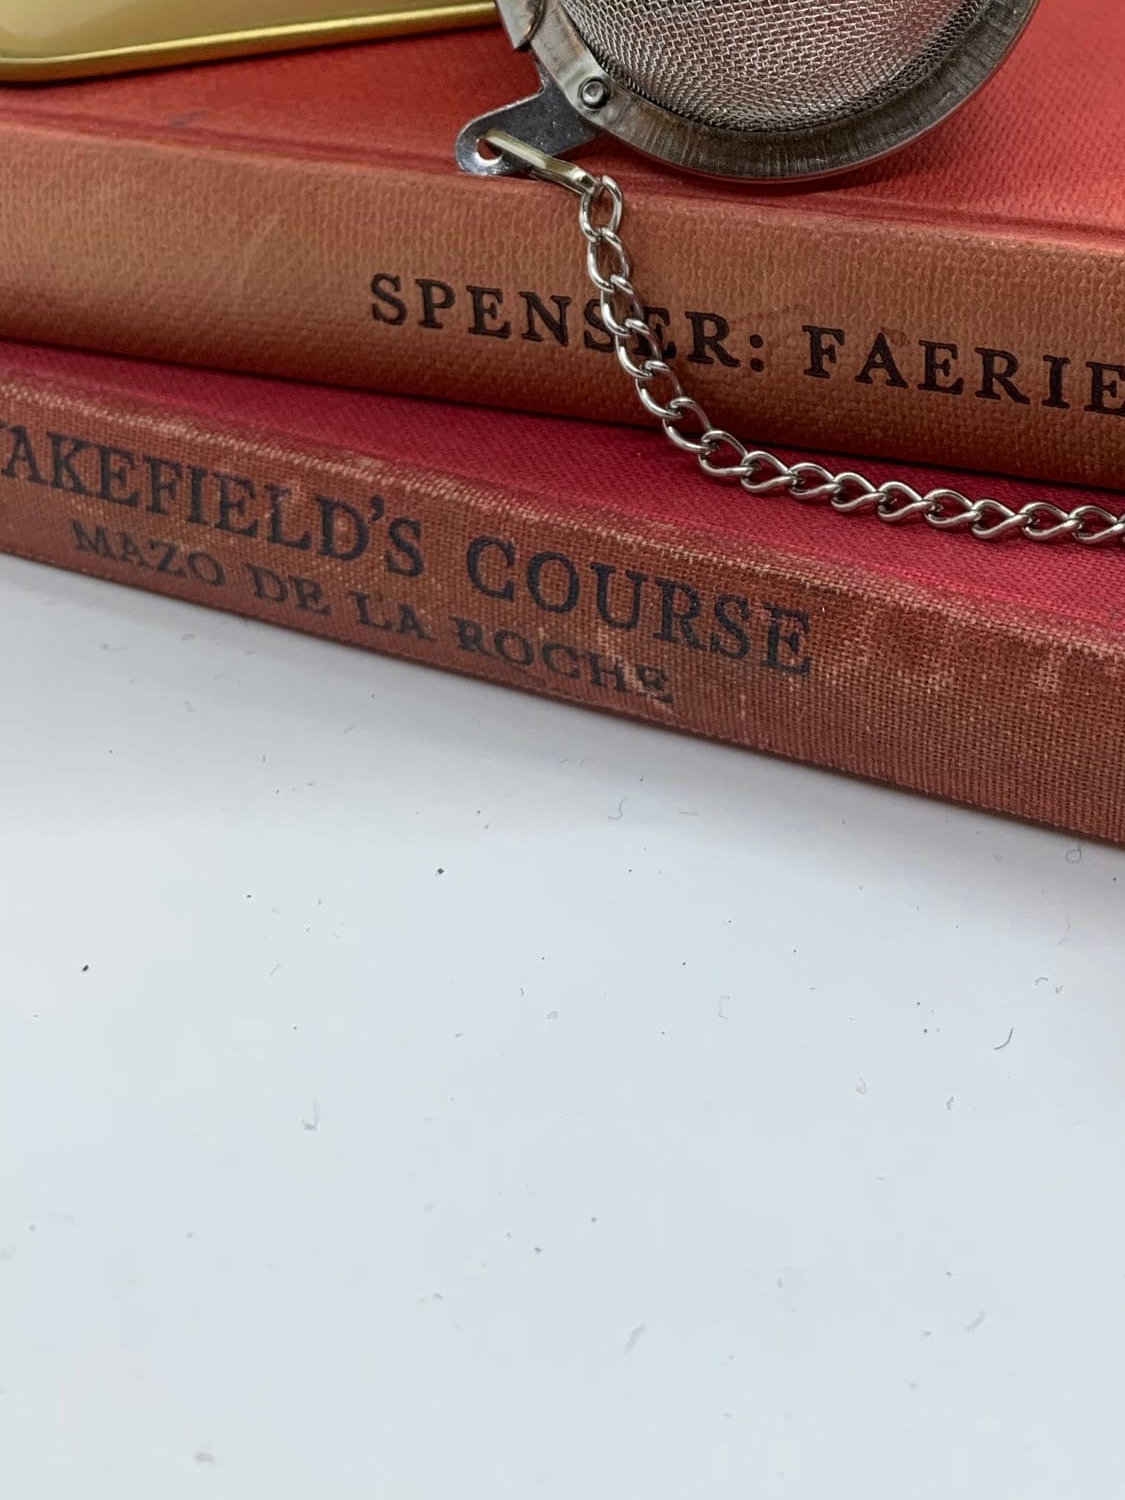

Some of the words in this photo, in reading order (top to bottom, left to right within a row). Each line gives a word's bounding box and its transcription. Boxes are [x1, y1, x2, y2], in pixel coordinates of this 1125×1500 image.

[0, 420, 425, 578] AKEFIELD'S
[466, 536, 813, 676] COURSE
[69, 518, 225, 586] MAZO
[246, 563, 332, 616] DE
[350, 590, 437, 642] LA
[448, 616, 674, 704] ROCHE
